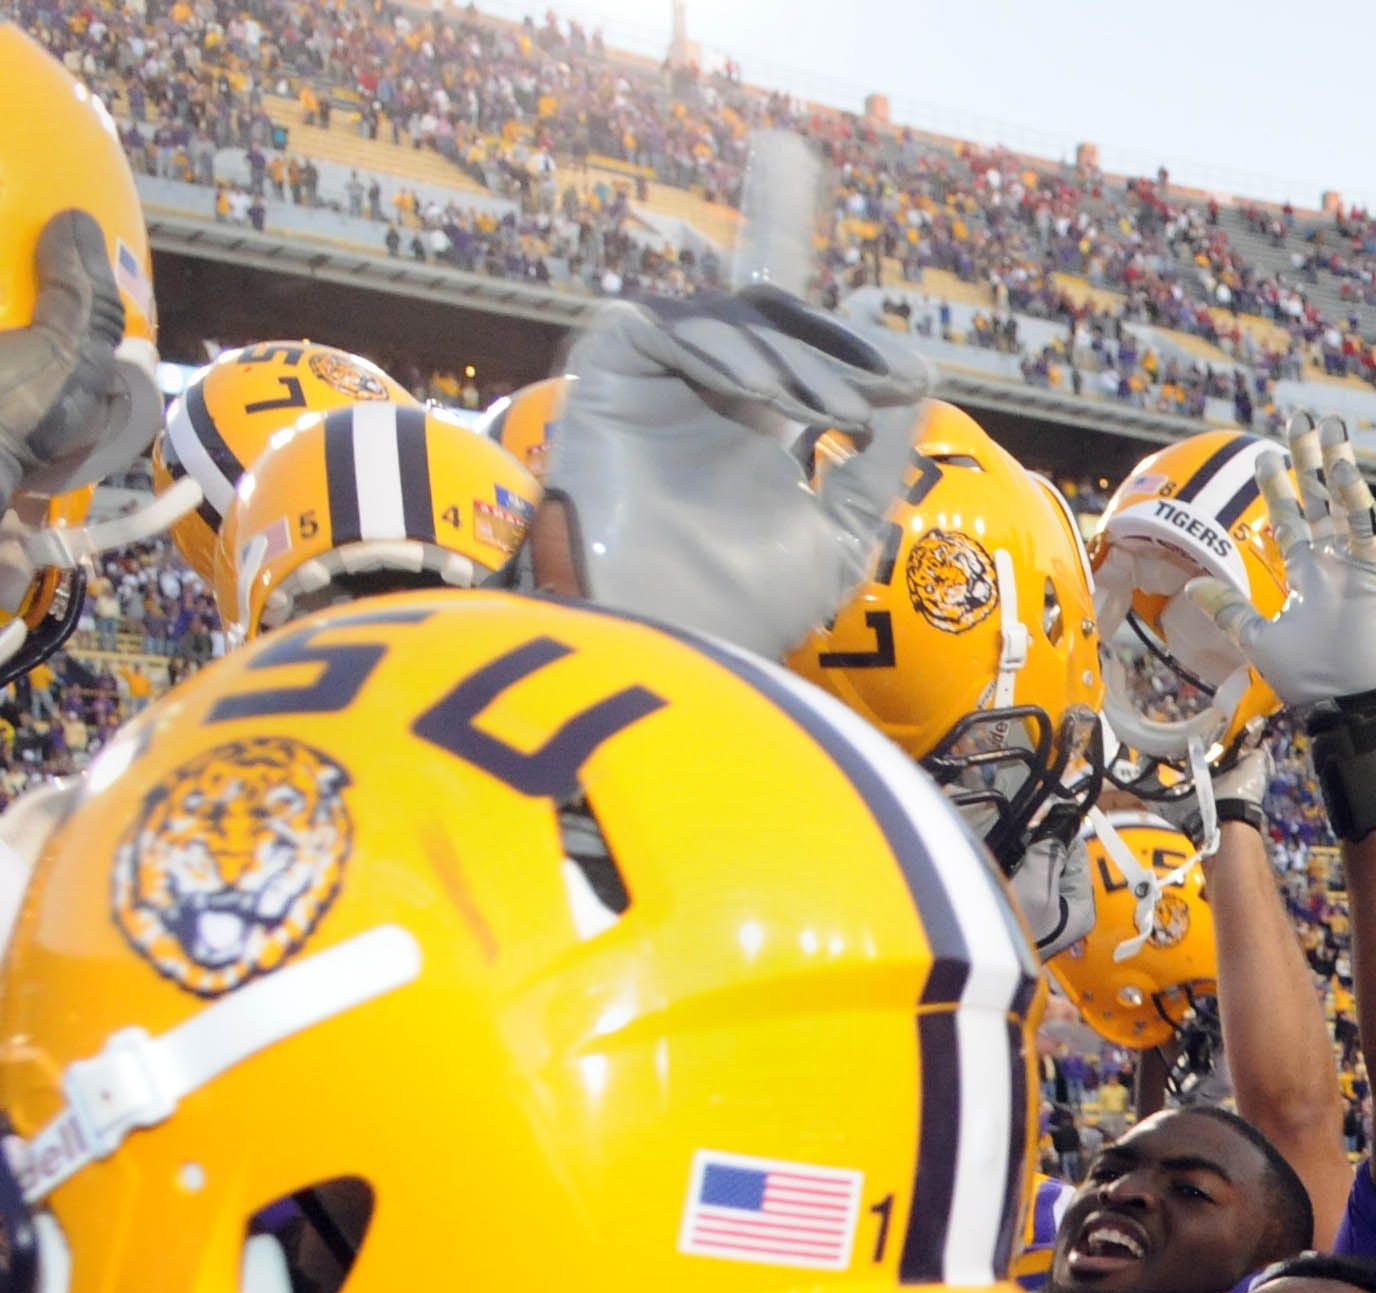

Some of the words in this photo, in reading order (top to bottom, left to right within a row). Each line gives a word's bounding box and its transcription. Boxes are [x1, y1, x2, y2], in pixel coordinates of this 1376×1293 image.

[299, 510, 318, 538] 5
[441, 505, 462, 529] 4
[1153, 499, 1232, 557] TIGERS
[869, 1193, 895, 1264] 1
